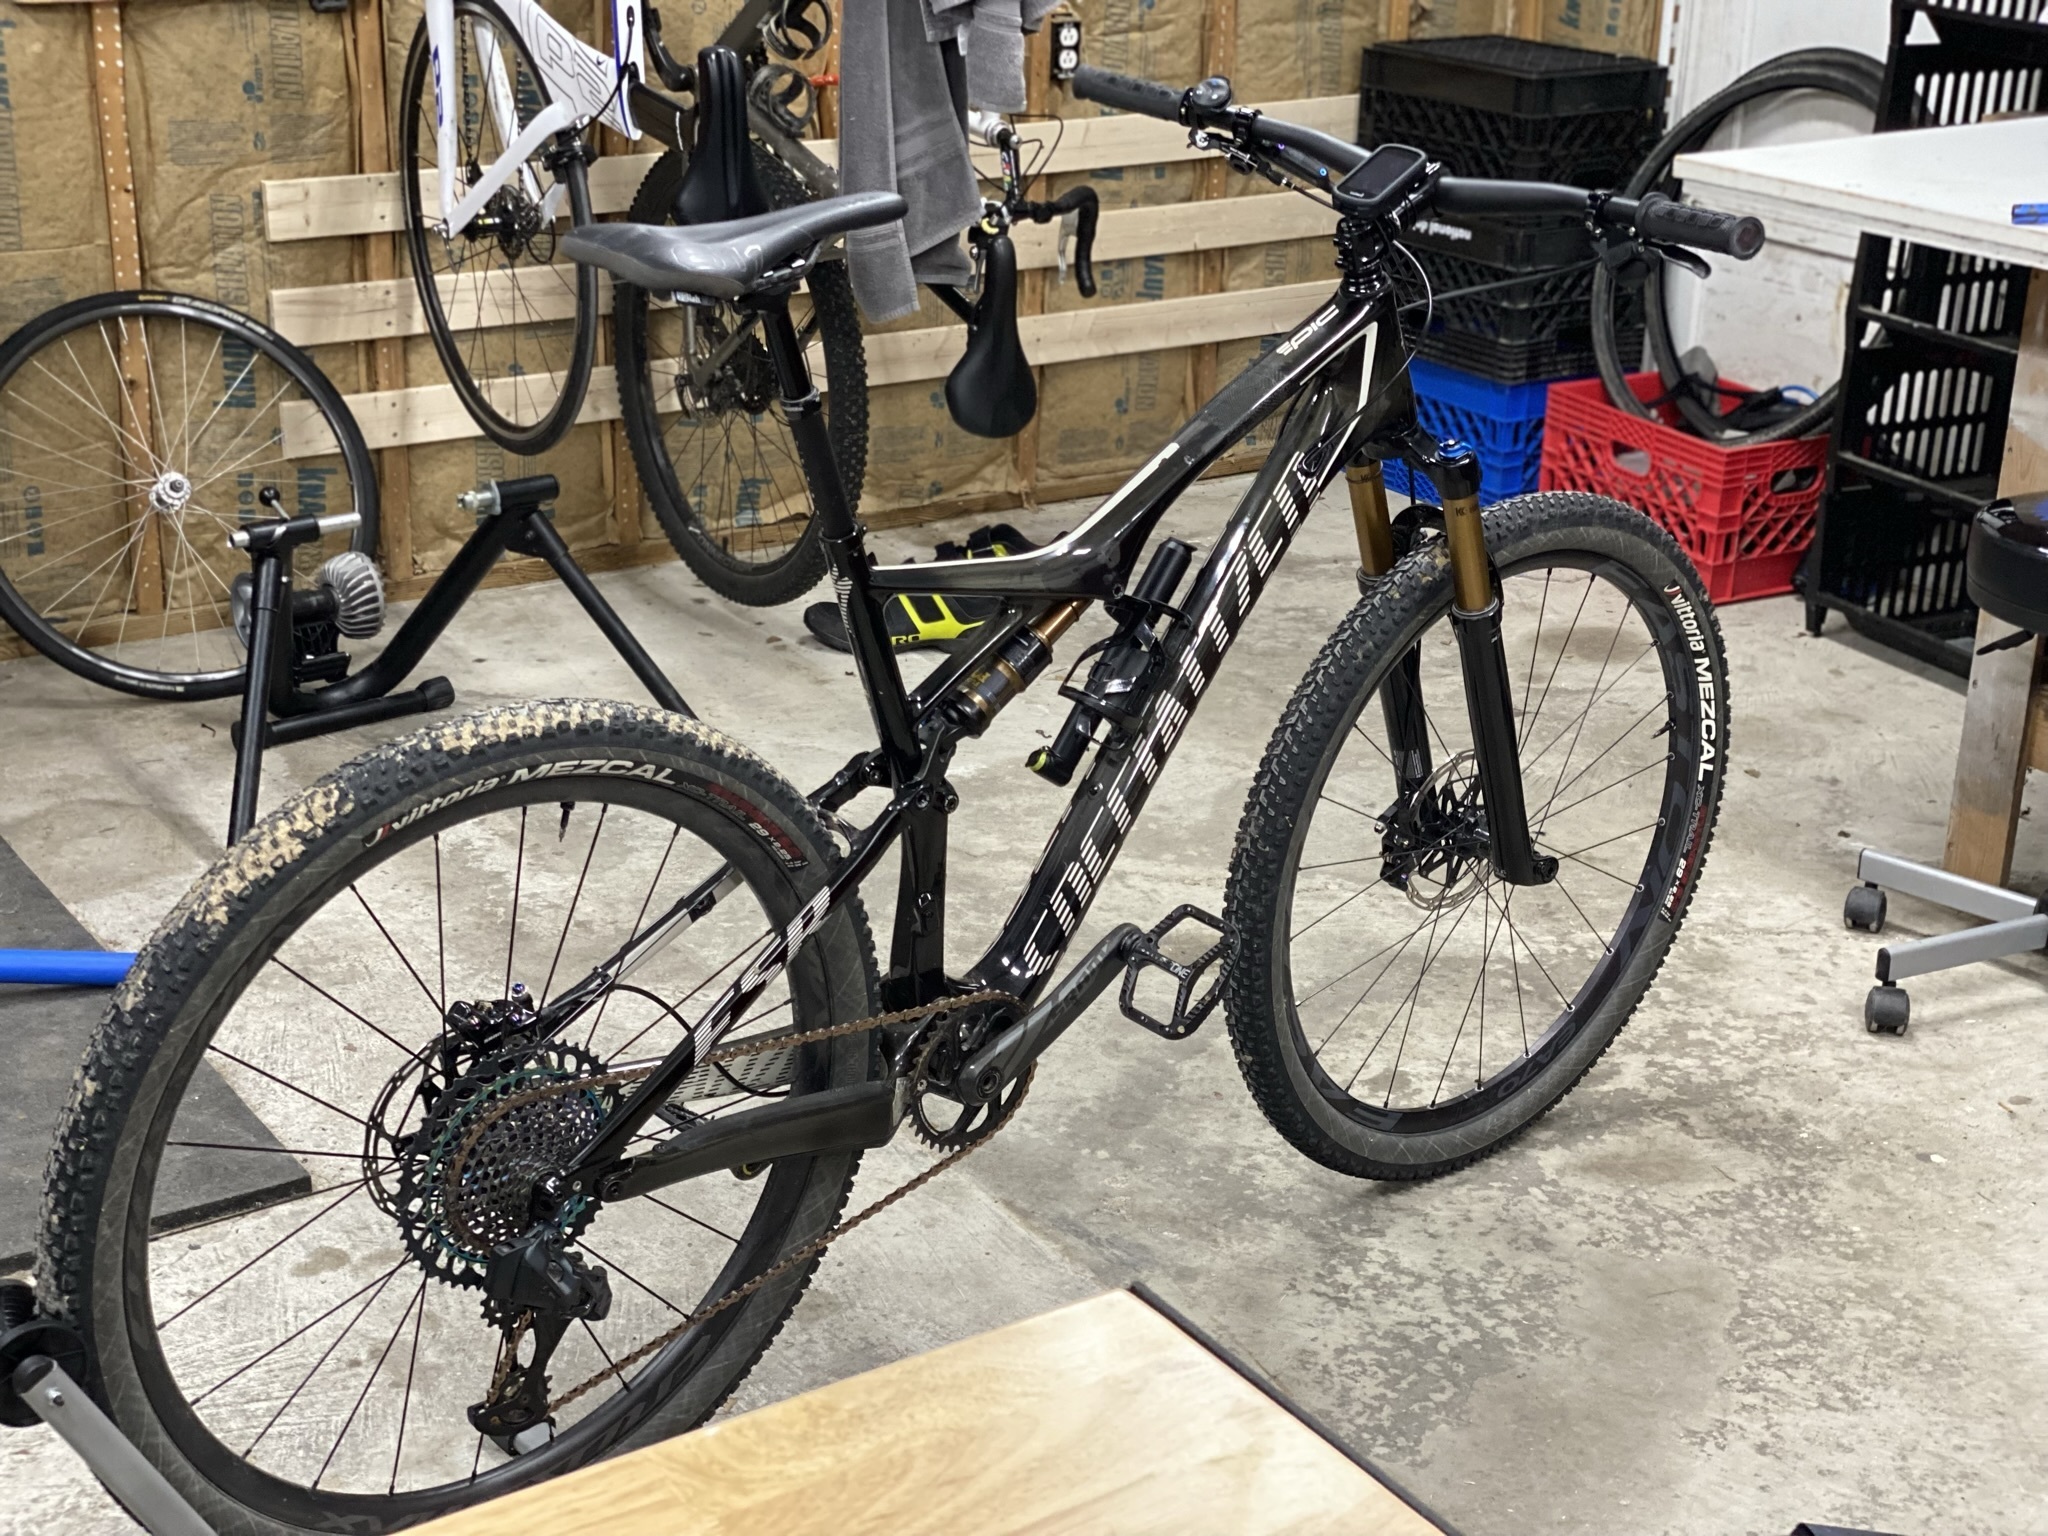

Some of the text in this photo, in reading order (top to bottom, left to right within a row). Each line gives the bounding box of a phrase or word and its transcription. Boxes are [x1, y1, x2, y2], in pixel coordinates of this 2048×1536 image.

[1276, 304, 1339, 356] EPIC
[1670, 594, 1705, 652] vittoria
[1694, 657, 1717, 781] MEZCAL
[391, 777, 500, 830] vittoria
[507, 759, 677, 785] MEZCAL
[748, 822, 769, 837] 29
[1675, 857, 1687, 878] 29
